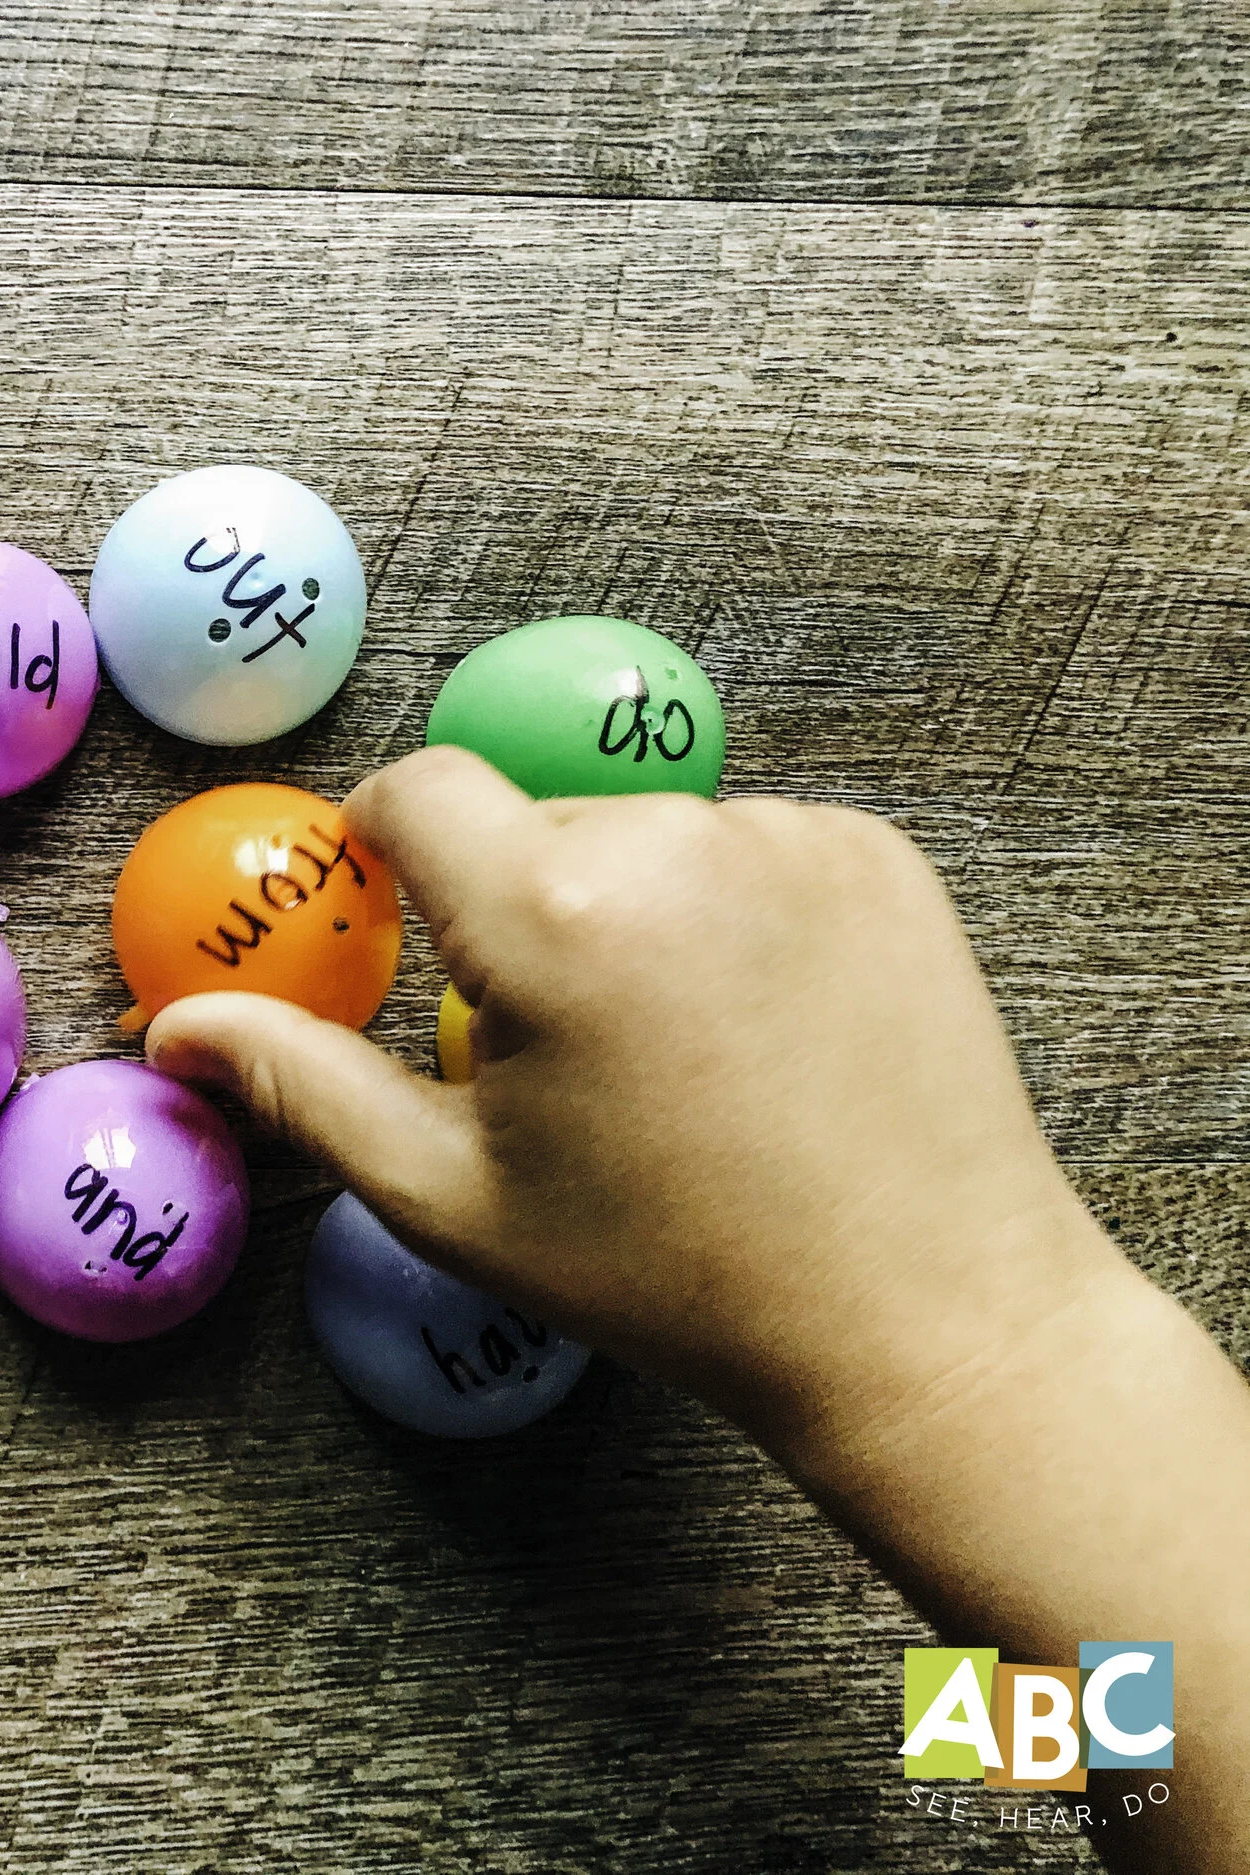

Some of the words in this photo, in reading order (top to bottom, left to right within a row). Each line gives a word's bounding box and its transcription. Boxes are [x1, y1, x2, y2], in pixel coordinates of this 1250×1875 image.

[183, 527, 316, 664] out
[597, 664, 695, 764] do
[195, 822, 367, 969] from
[63, 1162, 191, 1282] and
